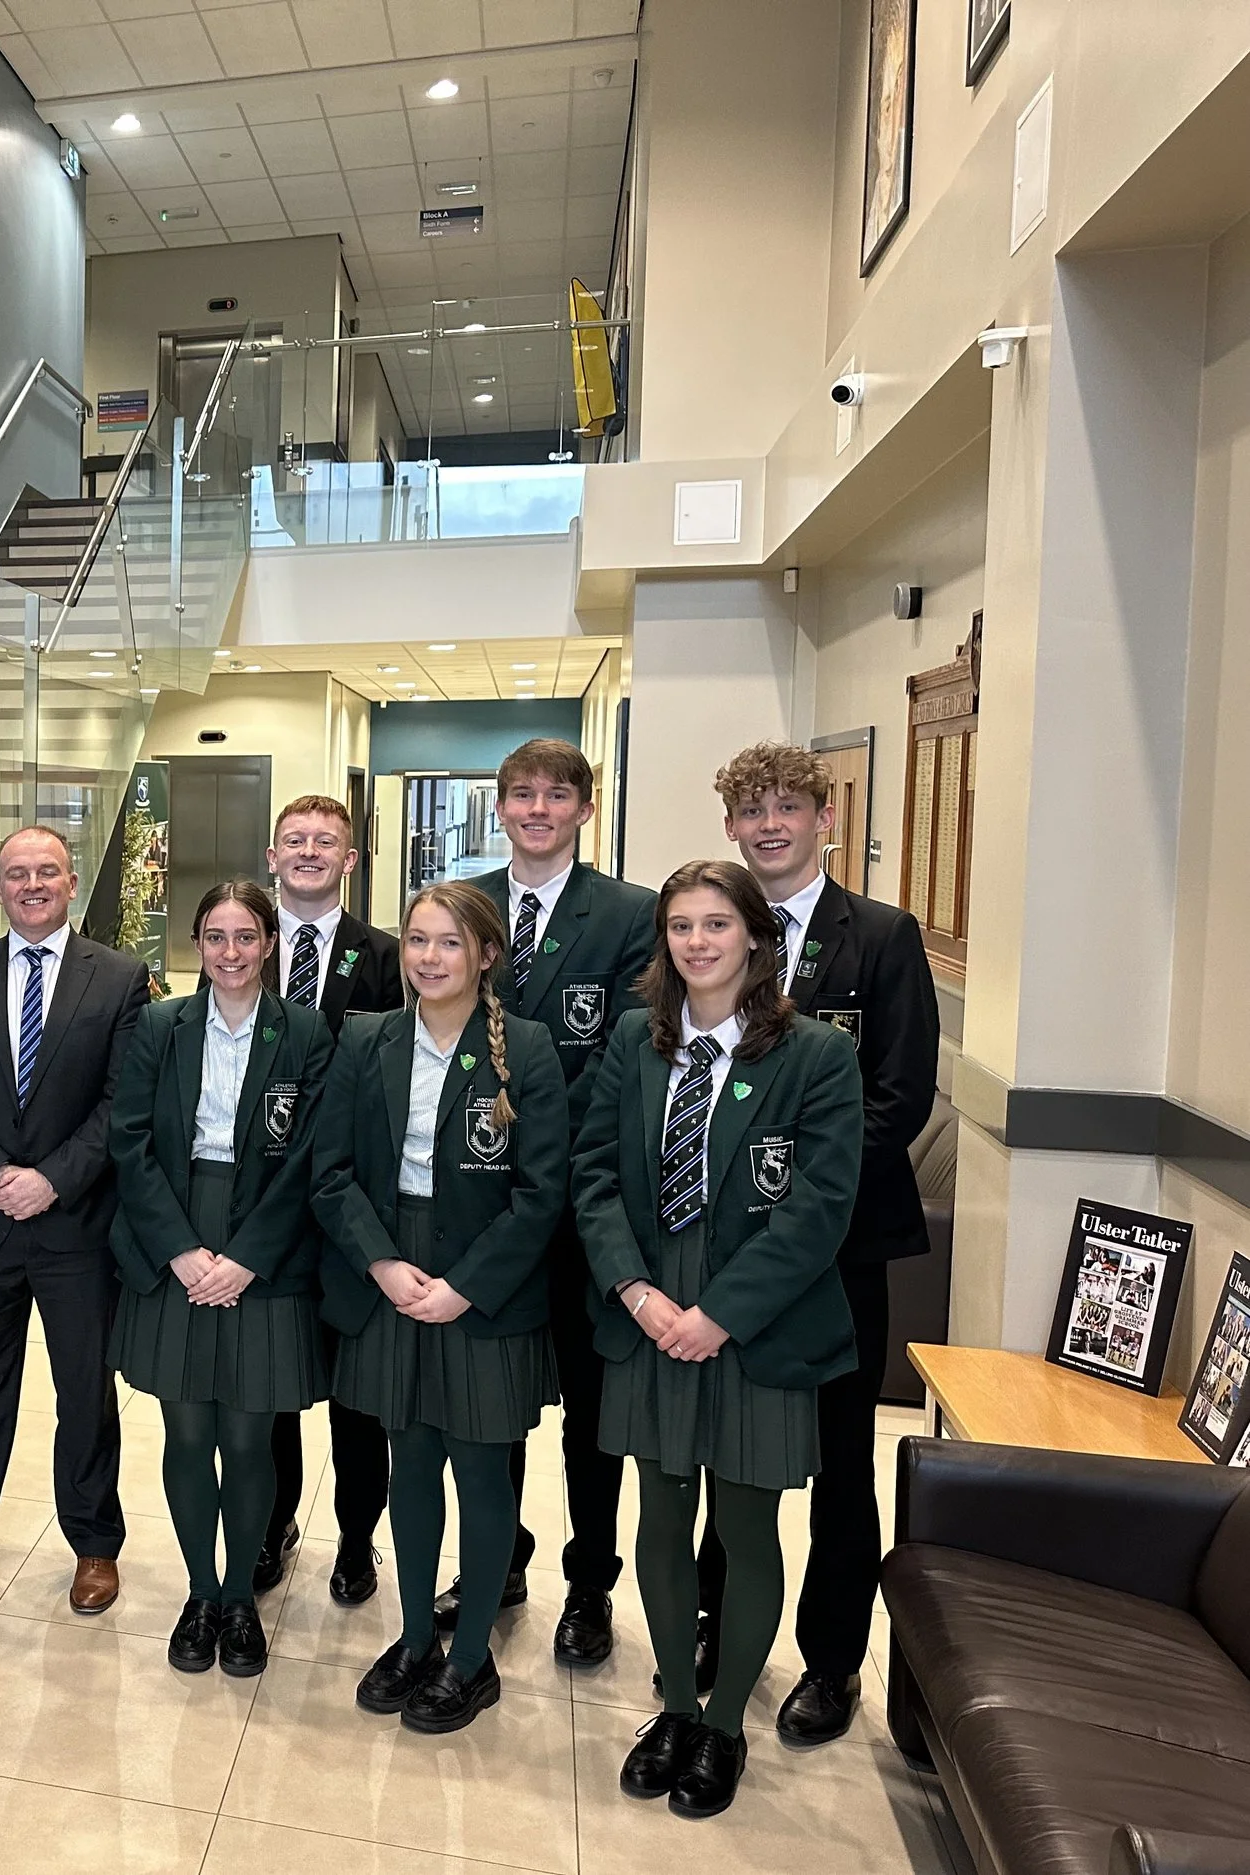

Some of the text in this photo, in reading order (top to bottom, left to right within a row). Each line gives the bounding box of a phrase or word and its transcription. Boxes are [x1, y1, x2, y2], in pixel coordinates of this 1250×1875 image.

[762, 1135, 784, 1144] MUSIC
[459, 1163, 483, 1171] DEPUTY
[483, 1164, 500, 1172] HEAD
[1081, 1213, 1182, 1253] Ulster Tatler
